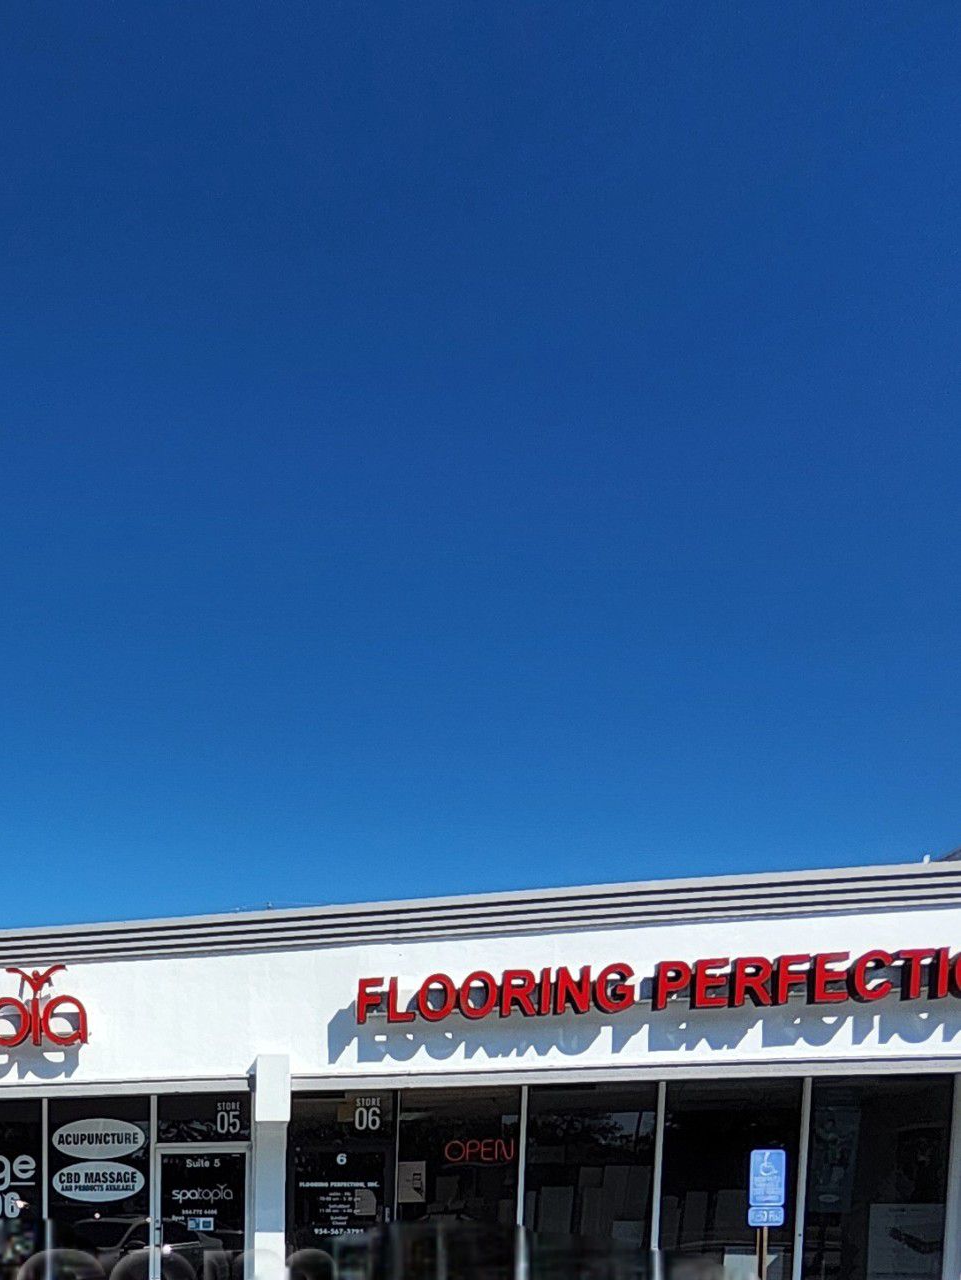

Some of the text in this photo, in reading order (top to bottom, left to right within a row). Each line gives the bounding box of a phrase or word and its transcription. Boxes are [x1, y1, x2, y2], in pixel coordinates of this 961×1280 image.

[357, 946, 961, 1025] FLOORING PERFECTI
[217, 1101, 240, 1111] STORE
[356, 1097, 380, 1107] STORE
[217, 1111, 240, 1134] 05
[354, 1107, 380, 1131] 06
[58, 1132, 139, 1145] ACUPUNCTURE
[444, 1139, 514, 1162] OPEN
[186, 1158, 221, 1168] Suite 5
[336, 1153, 347, 1165] 6
[58, 1171, 137, 1184] CBD MASSAGE
[74, 1184, 104, 1192] PRODUCTS
[171, 1183, 234, 1204] spatopia
